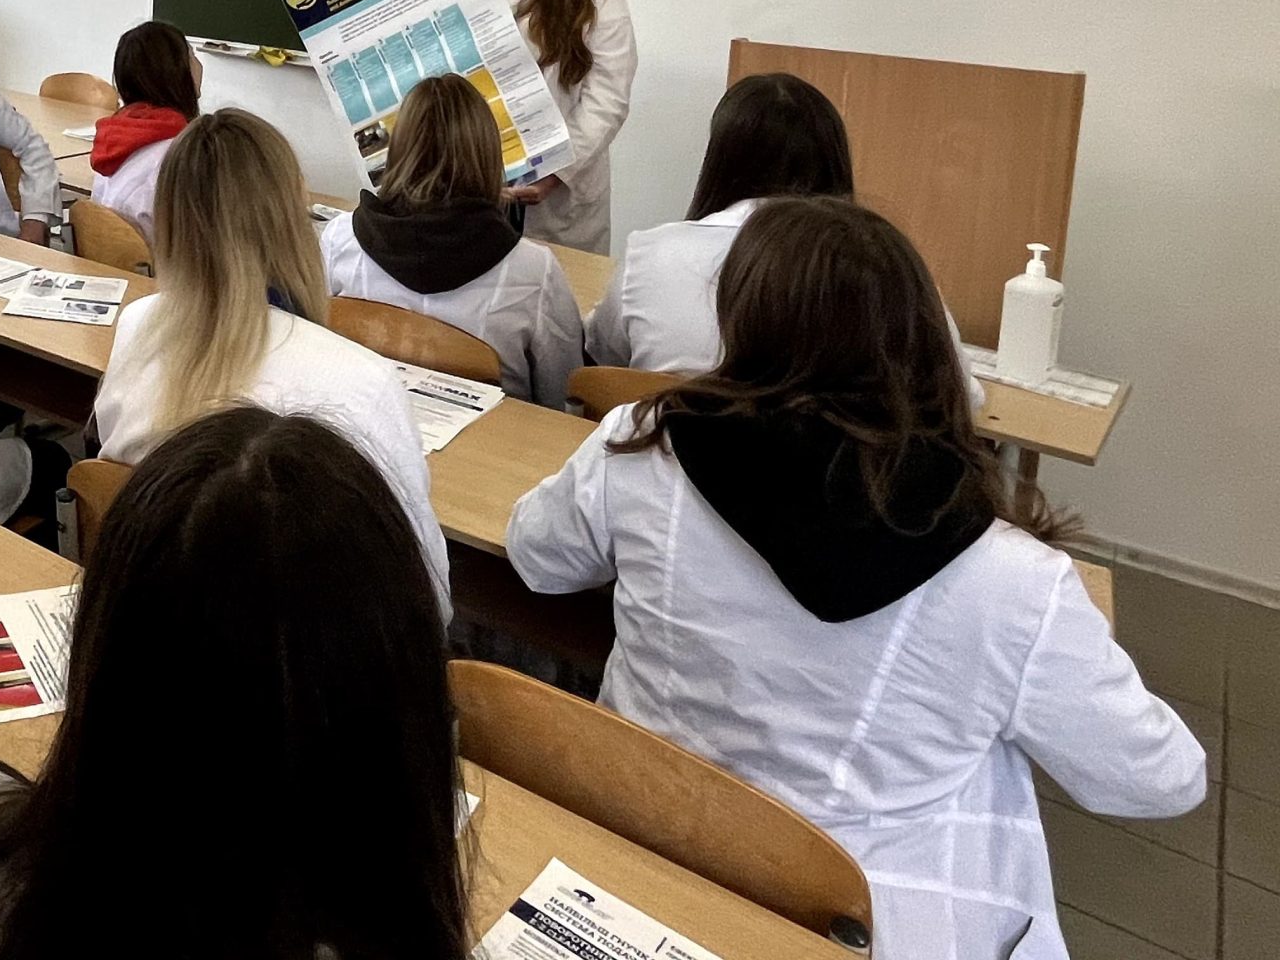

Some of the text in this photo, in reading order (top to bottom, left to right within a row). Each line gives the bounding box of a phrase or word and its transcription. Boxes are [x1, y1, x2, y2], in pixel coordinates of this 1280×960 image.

[543, 902, 595, 939] СИСТЕМА
[549, 895, 610, 937] НАЙБІЛЬШ
[610, 934, 655, 960] ГНУЧК
